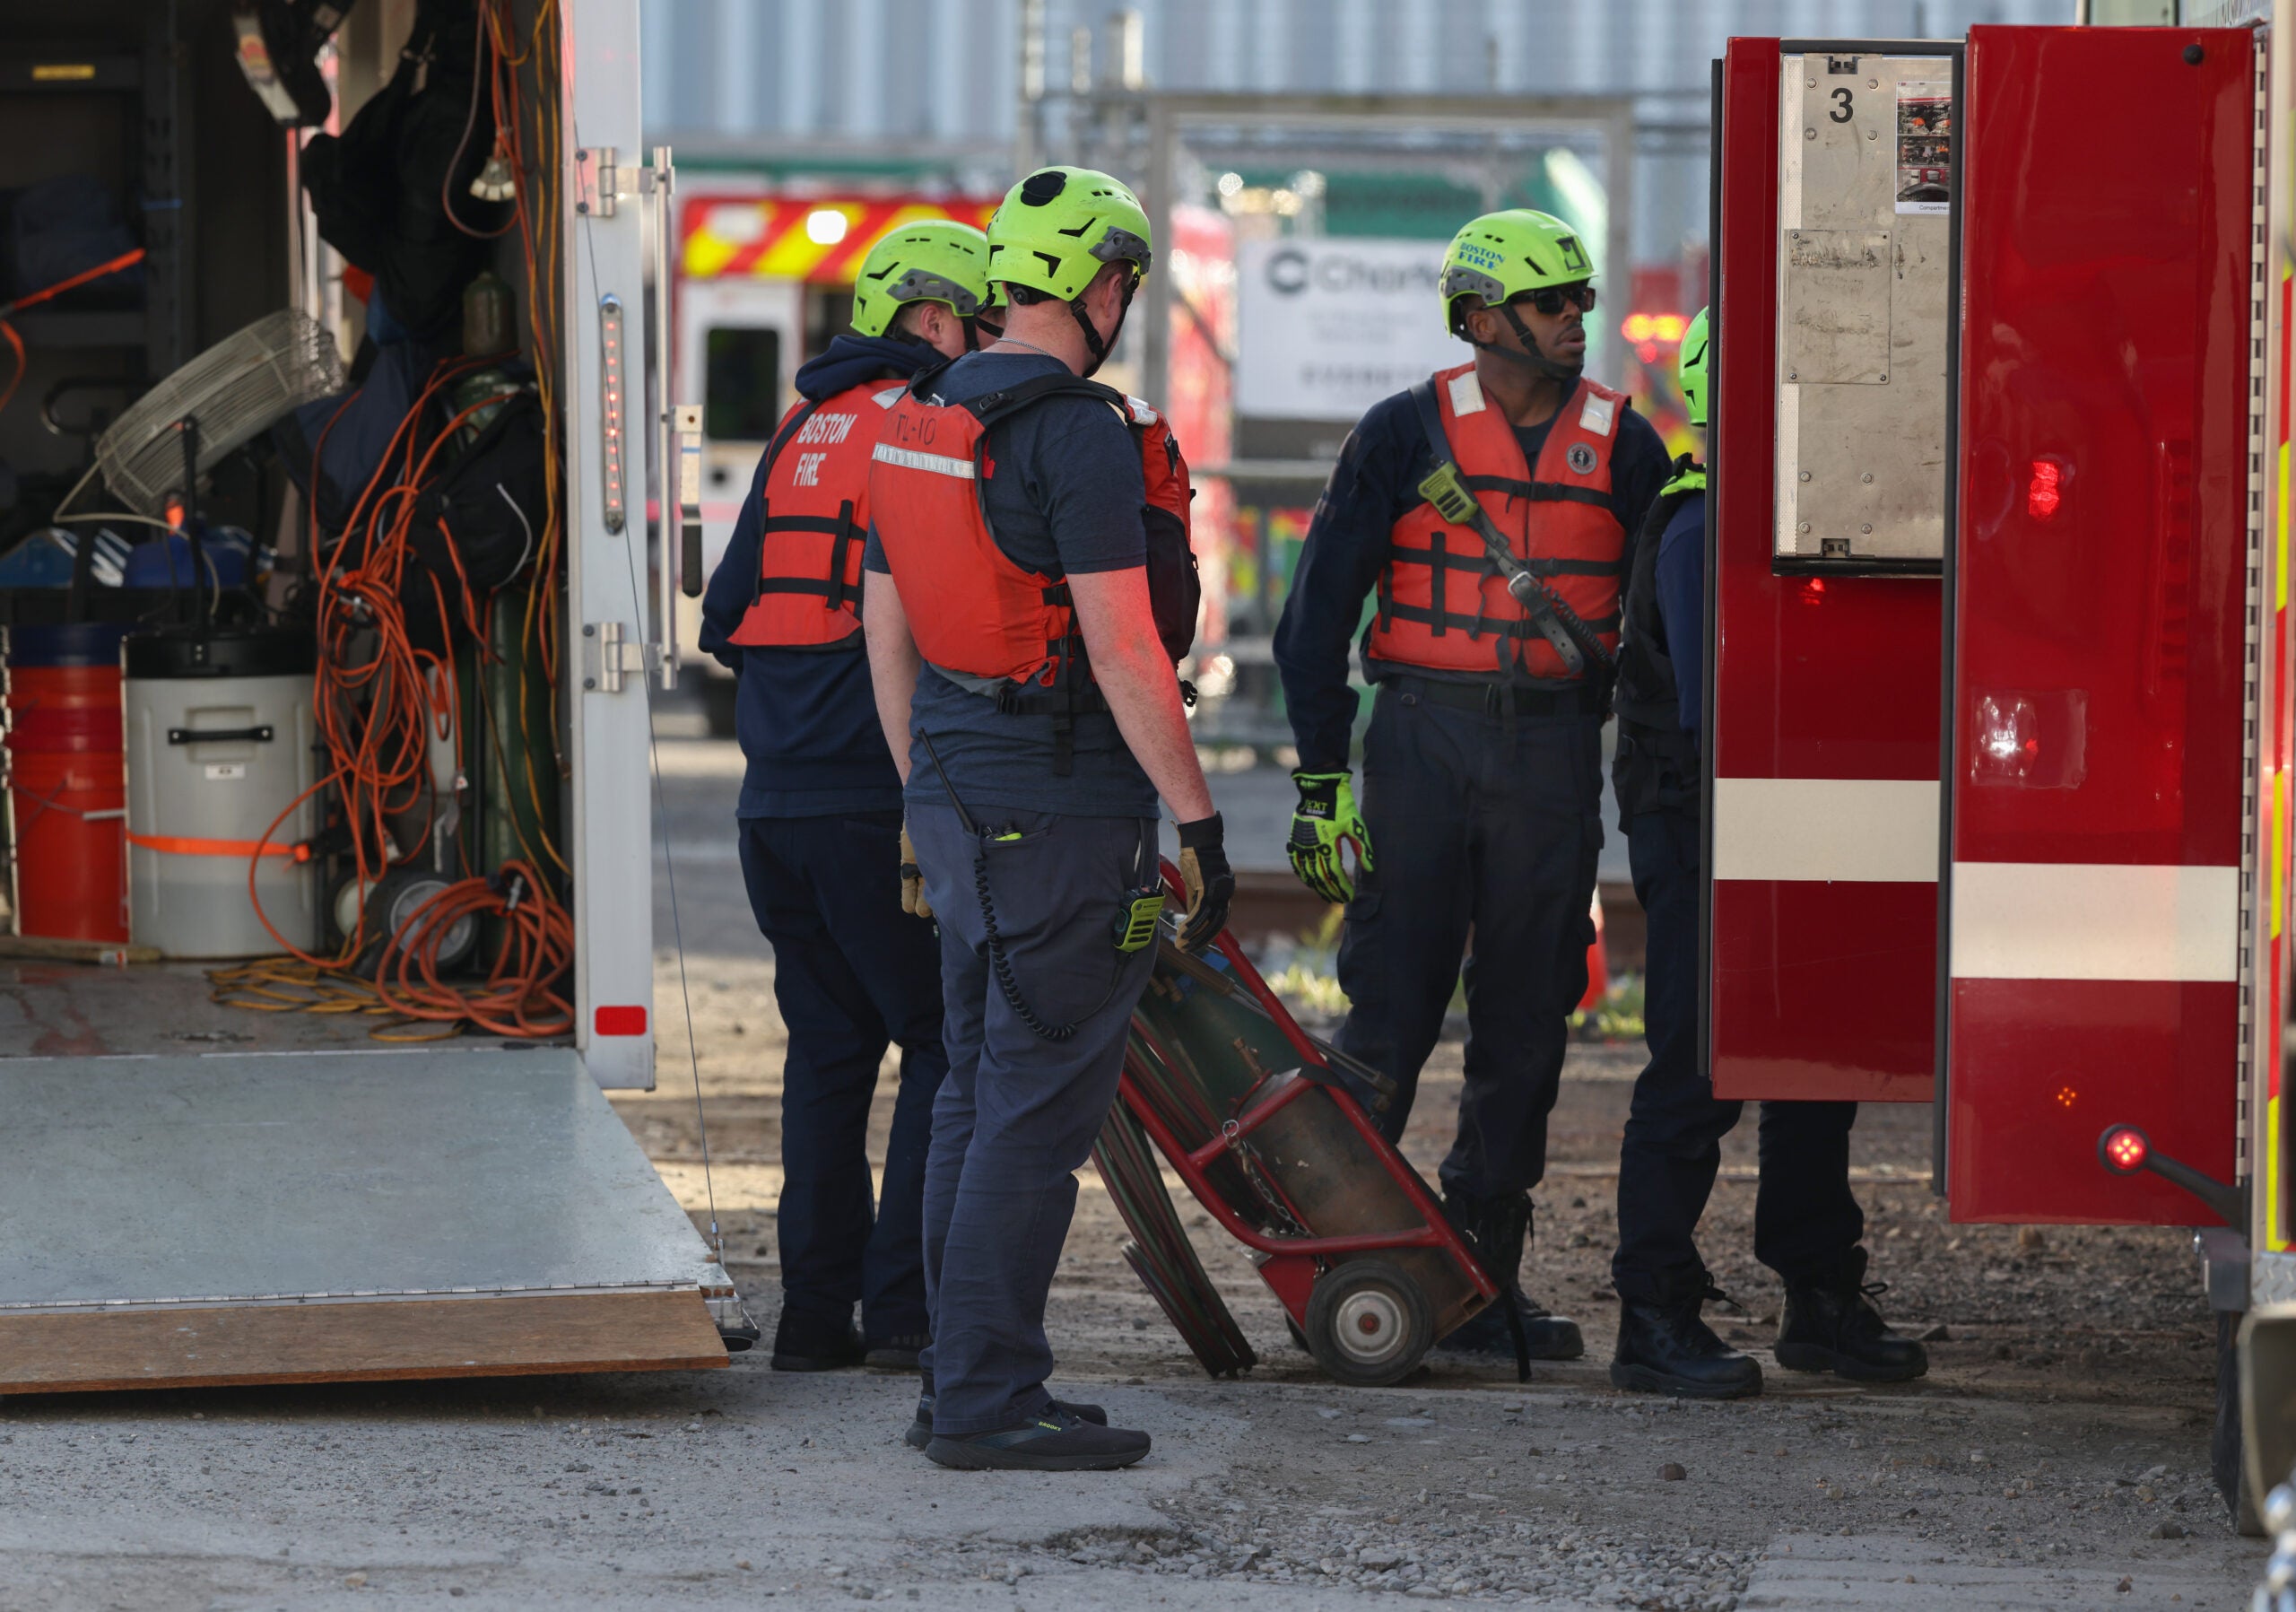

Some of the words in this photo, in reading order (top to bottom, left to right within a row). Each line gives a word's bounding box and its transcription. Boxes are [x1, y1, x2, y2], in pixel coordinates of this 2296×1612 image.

[1830, 87, 1854, 123] 3
[1458, 251, 1499, 271] FIRE
[1460, 242, 1506, 263] BOSTON
[796, 414, 857, 444] BOSTON
[897, 414, 936, 445] TL-10
[793, 453, 827, 487] FIRE
[1038, 1421, 1062, 1432] BROOKS
